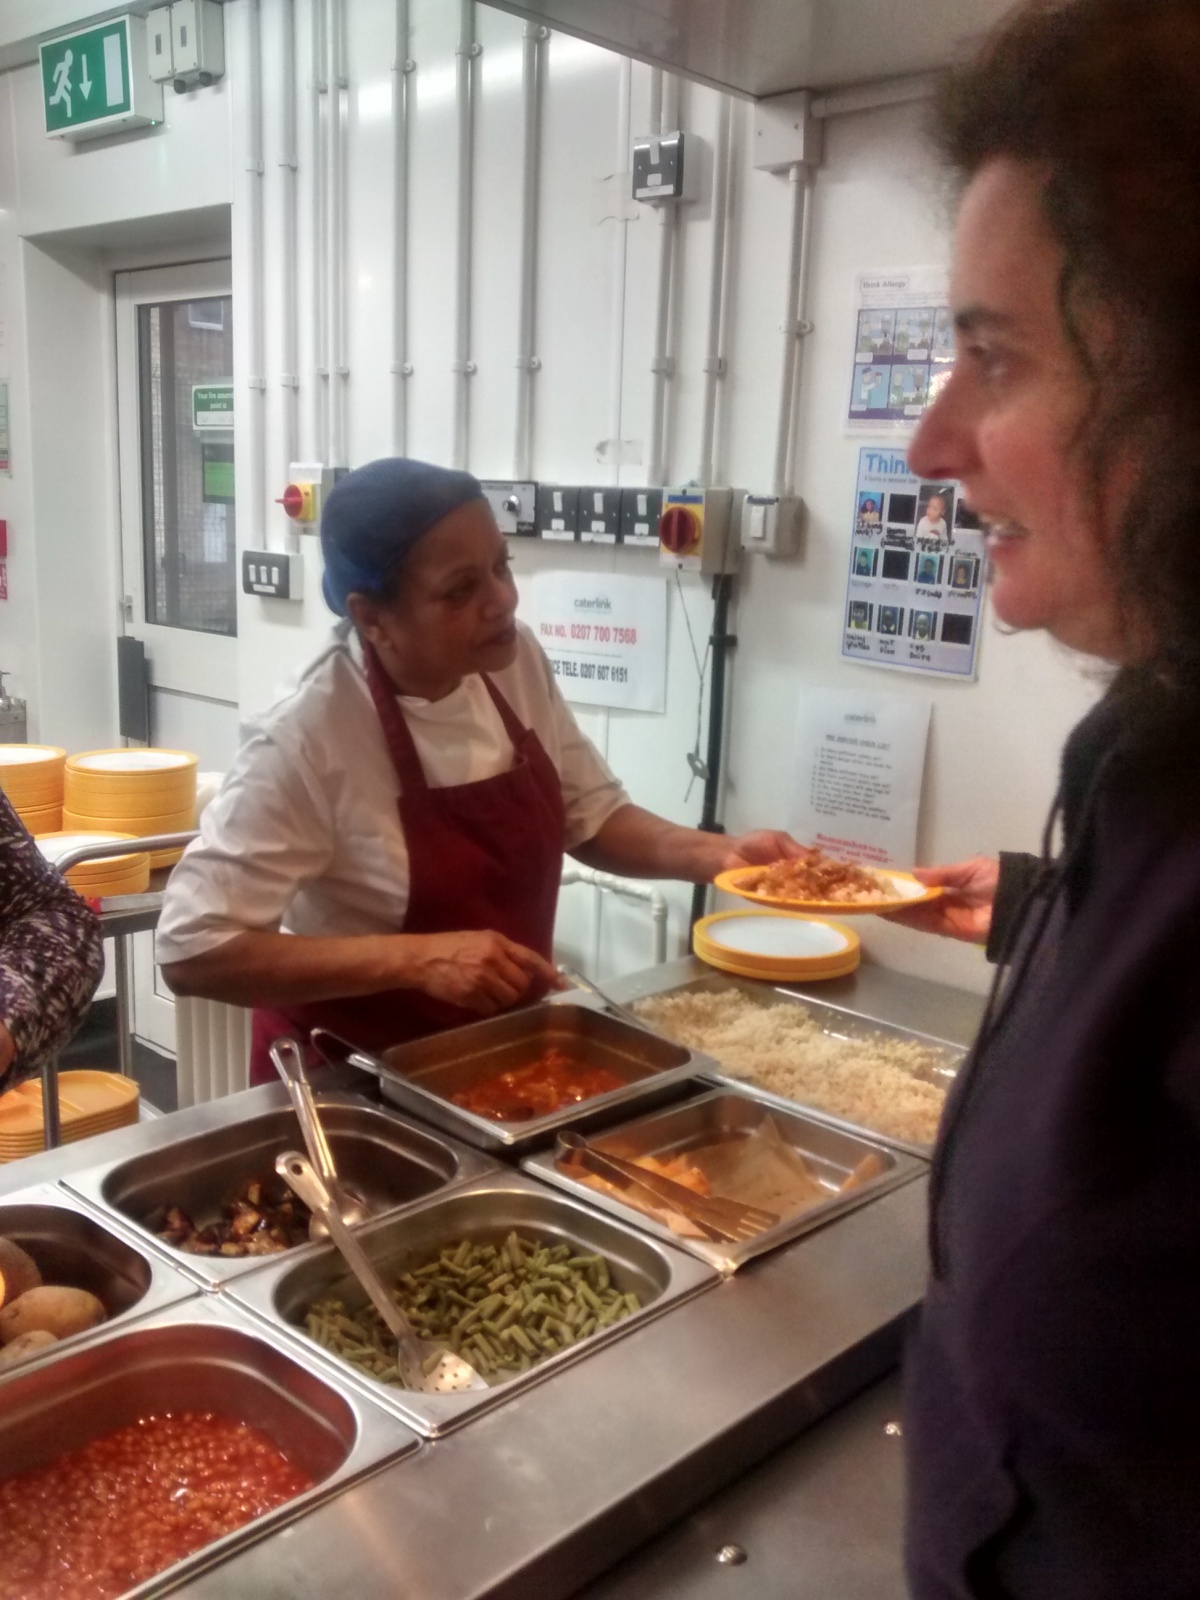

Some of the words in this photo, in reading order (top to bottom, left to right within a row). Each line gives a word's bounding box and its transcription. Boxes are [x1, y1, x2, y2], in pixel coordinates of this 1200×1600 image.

[865, 453, 910, 475] Thin
[574, 598, 612, 610] caterlink
[540, 623, 553, 636] FAX
[554, 624, 567, 638] NO.
[571, 624, 591, 640] 0207
[594, 626, 610, 643] 700
[613, 627, 637, 645] 7568
[562, 661, 579, 677] TELE.
[580, 663, 596, 680] 0207
